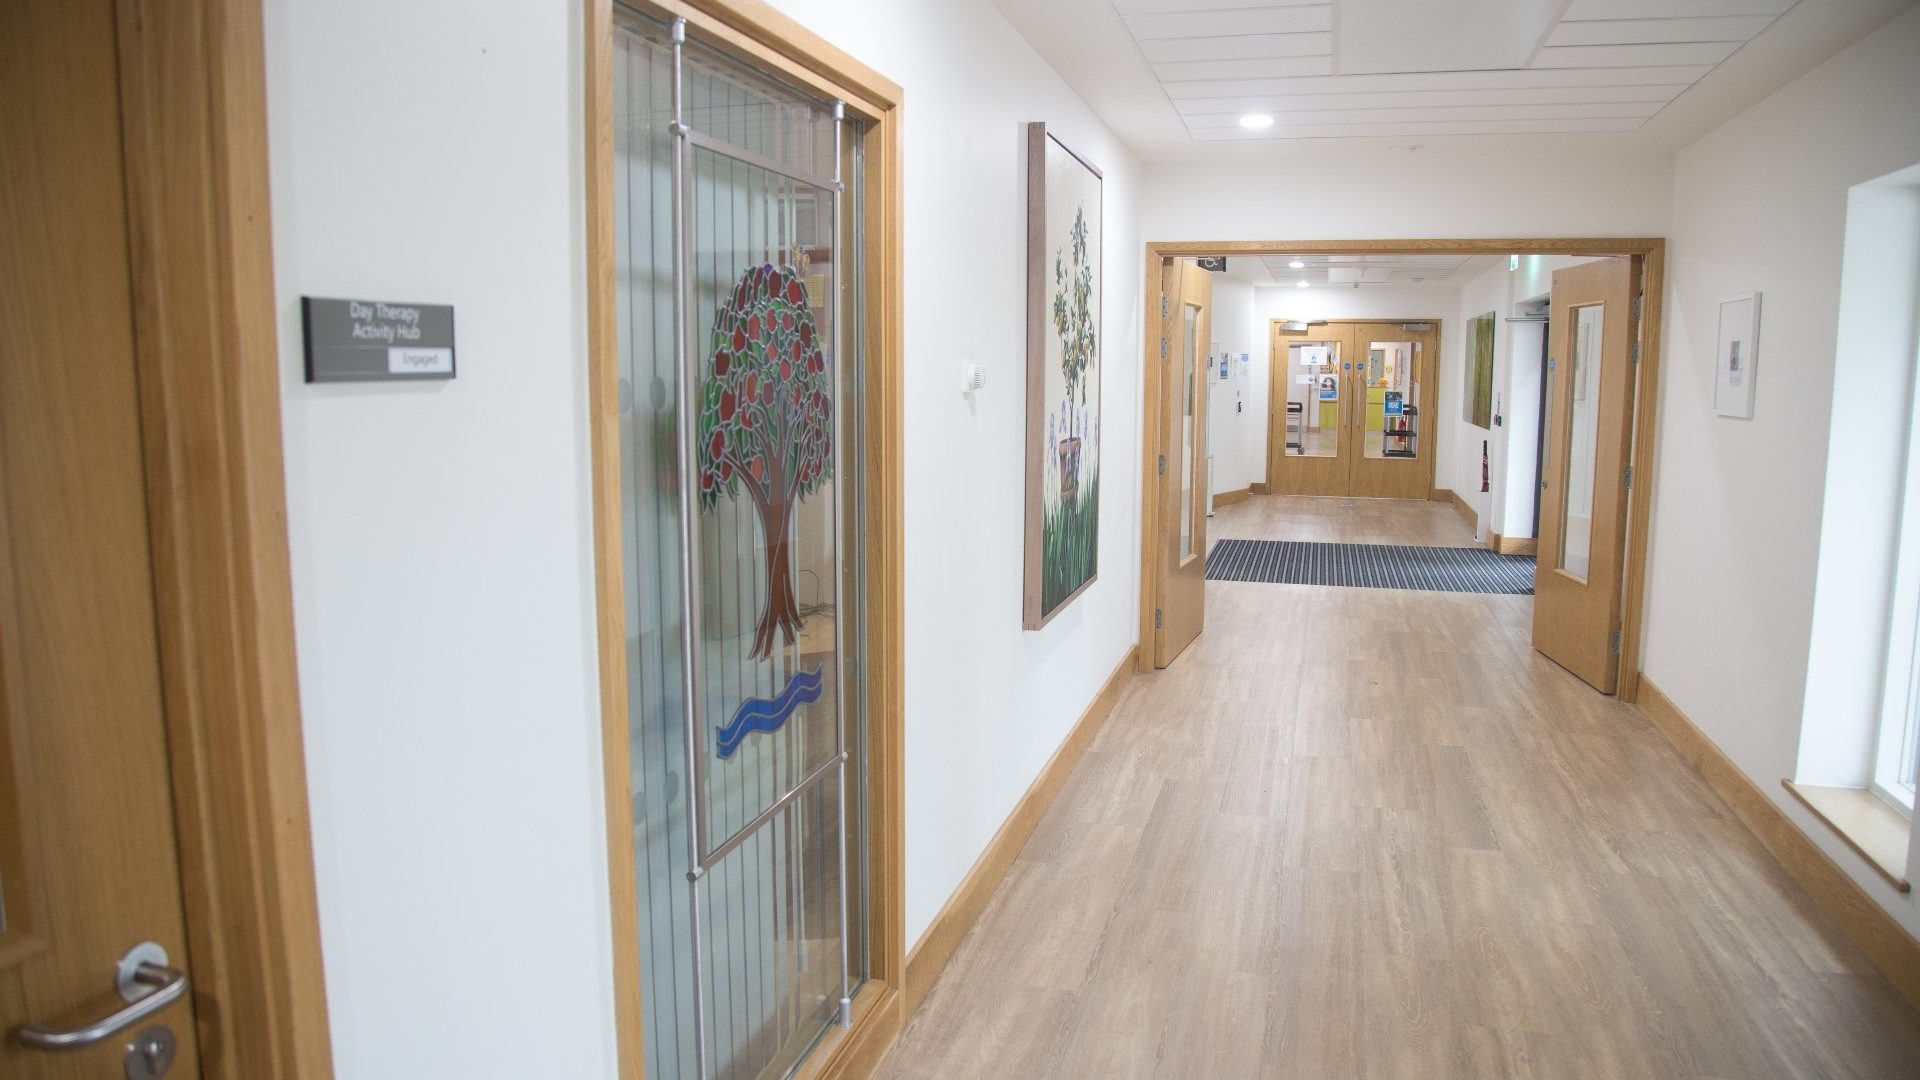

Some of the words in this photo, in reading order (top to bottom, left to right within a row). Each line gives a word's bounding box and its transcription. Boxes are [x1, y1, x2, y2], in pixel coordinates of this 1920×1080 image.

[350, 302, 373, 322] Day
[376, 303, 420, 324] Therapy
[352, 323, 395, 342] Activity
[397, 325, 421, 339] Hub
[402, 350, 438, 366] Engaged
